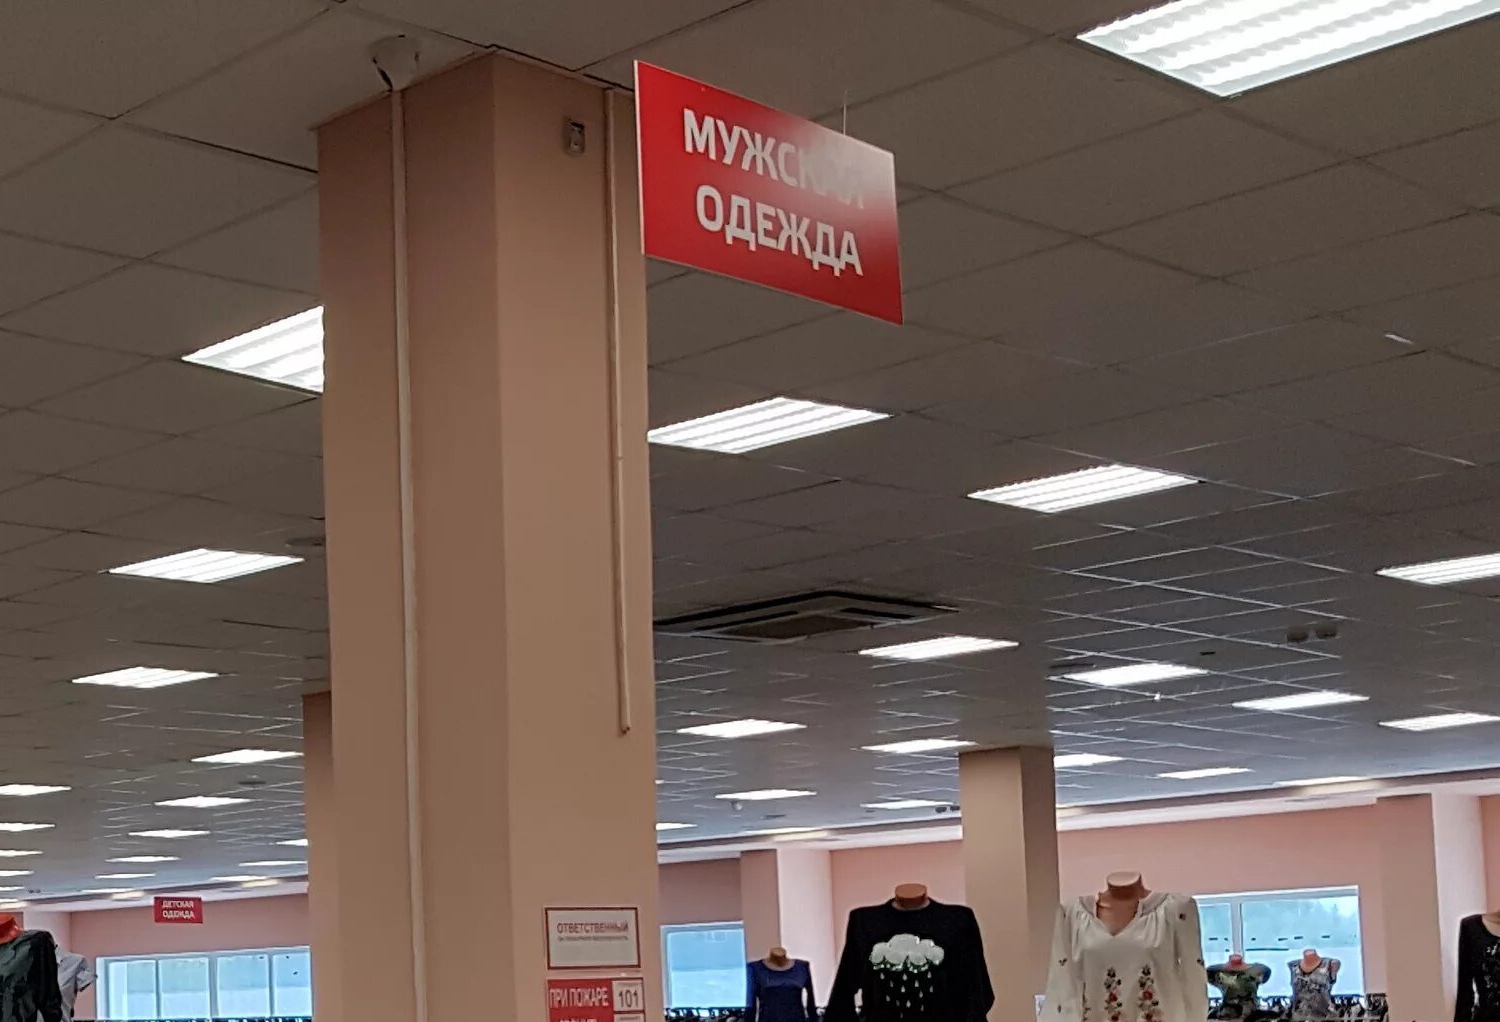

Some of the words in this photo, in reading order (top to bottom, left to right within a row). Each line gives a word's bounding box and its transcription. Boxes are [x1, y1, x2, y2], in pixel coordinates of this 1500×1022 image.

[683, 107, 865, 209] МУЖСК
[696, 184, 864, 277] ОДЕЖДА
[162, 910, 196, 919] ОДЕЖДА
[556, 920, 629, 934] ОТВЕТСТВЕННЫЙ
[550, 988, 568, 1008] ПРИ
[570, 987, 609, 1007] ПОЖАРЕ
[618, 989, 639, 1008] 101
